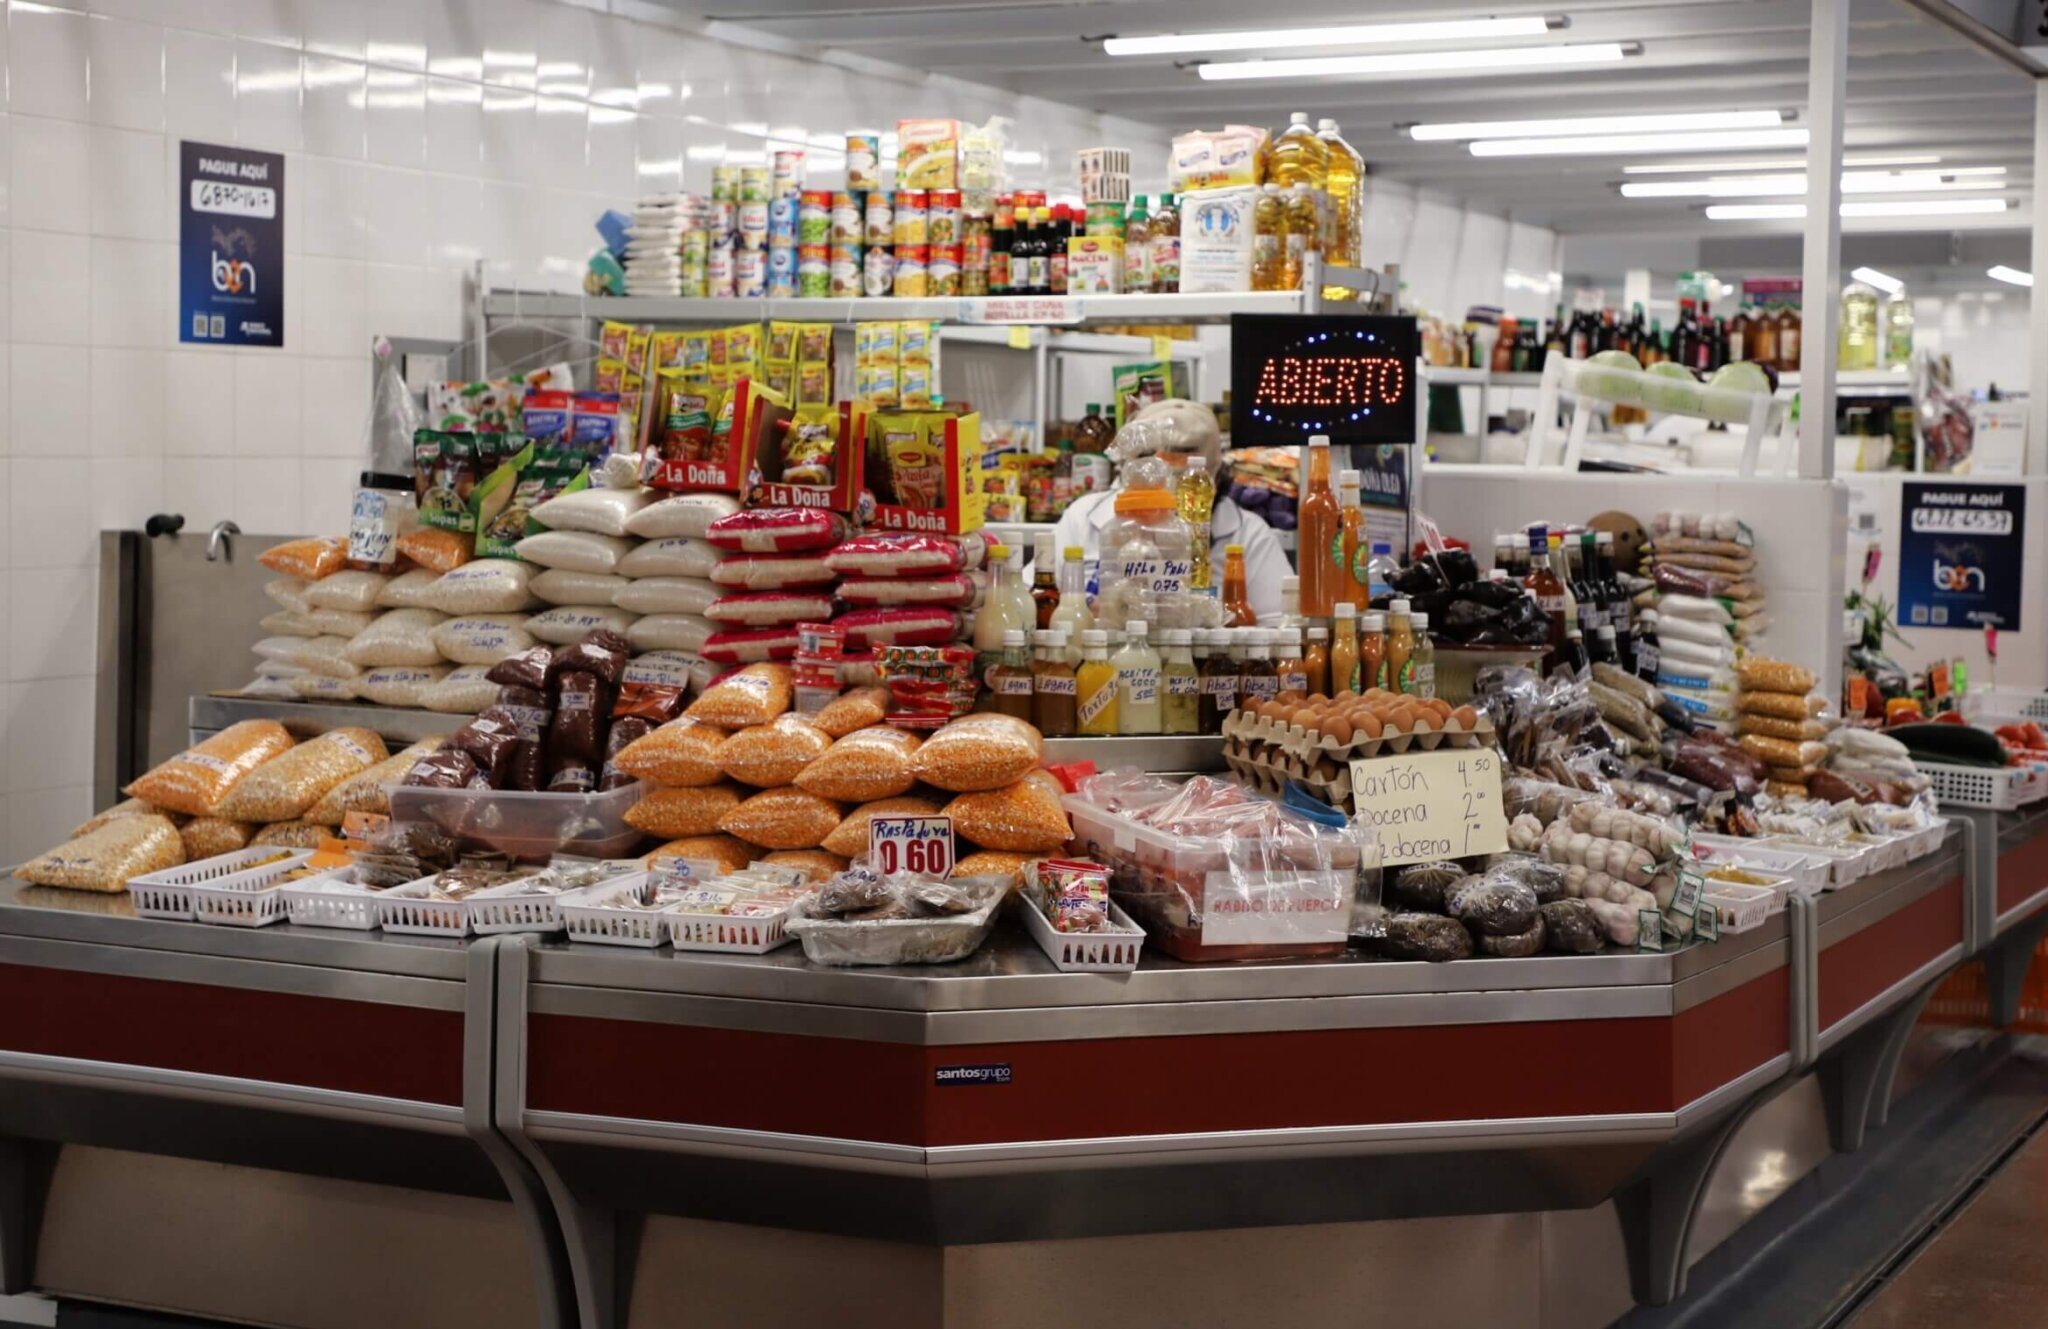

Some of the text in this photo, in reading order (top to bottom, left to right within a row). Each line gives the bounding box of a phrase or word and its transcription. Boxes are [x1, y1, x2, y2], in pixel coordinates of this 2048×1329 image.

[198, 158, 268, 180] PAGUE AQUÍ
[1255, 357, 1404, 404] ABIERTO
[666, 464, 727, 486] La Doña
[770, 485, 787, 504] La
[1921, 492, 1967, 505] PAGUE
[884, 509, 947, 531] La Doña
[1353, 764, 1430, 797] Cartón
[1391, 832, 1451, 859] docena
